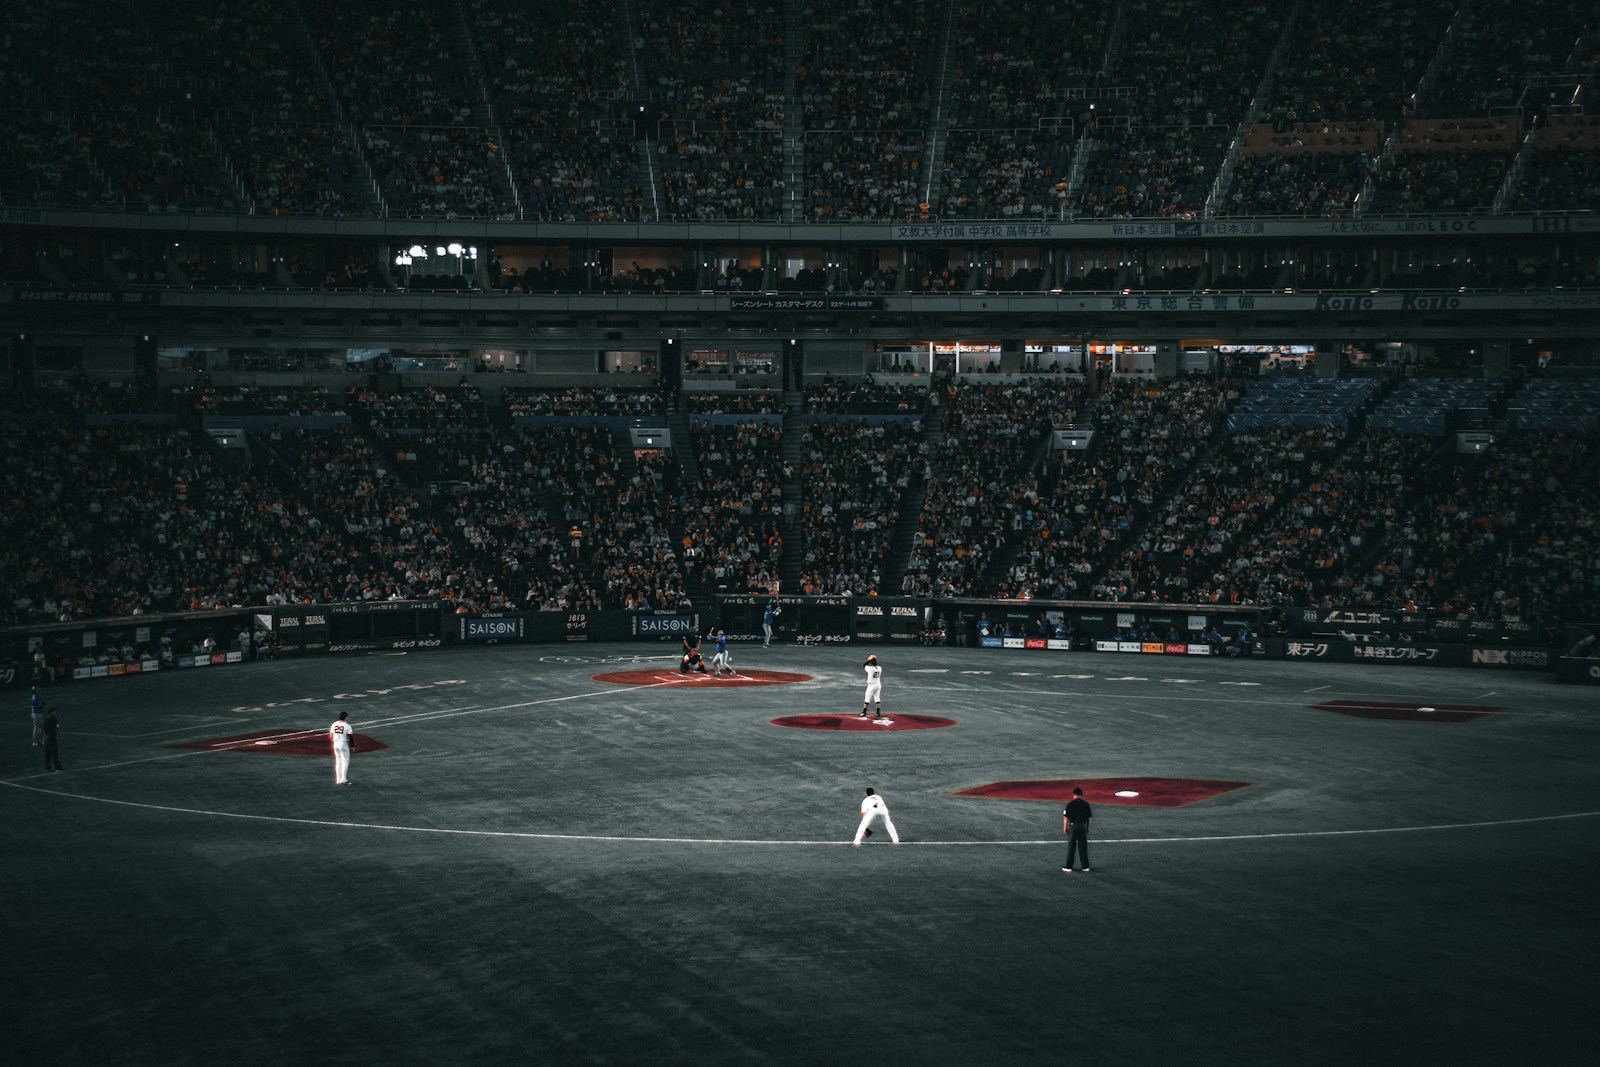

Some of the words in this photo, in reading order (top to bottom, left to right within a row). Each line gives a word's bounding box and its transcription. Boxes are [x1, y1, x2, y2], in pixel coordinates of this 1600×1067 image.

[898, 225, 965, 237] 文教大学付属
[969, 225, 1001, 237] 中学校
[1006, 225, 1050, 237] 高等学校
[1112, 224, 1172, 235] 新日本空調
[1204, 223, 1264, 234] 新日本空調
[731, 299, 773, 308] シーズンシート
[775, 300, 823, 308] カスタマーデスク
[1112, 296, 1255, 310] 東京総合警備
[469, 622, 515, 634] SAISON
[641, 620, 690, 631] SAISON
[1286, 643, 1328, 657] 東テク
[1364, 647, 1438, 659] 長谷工グループ
